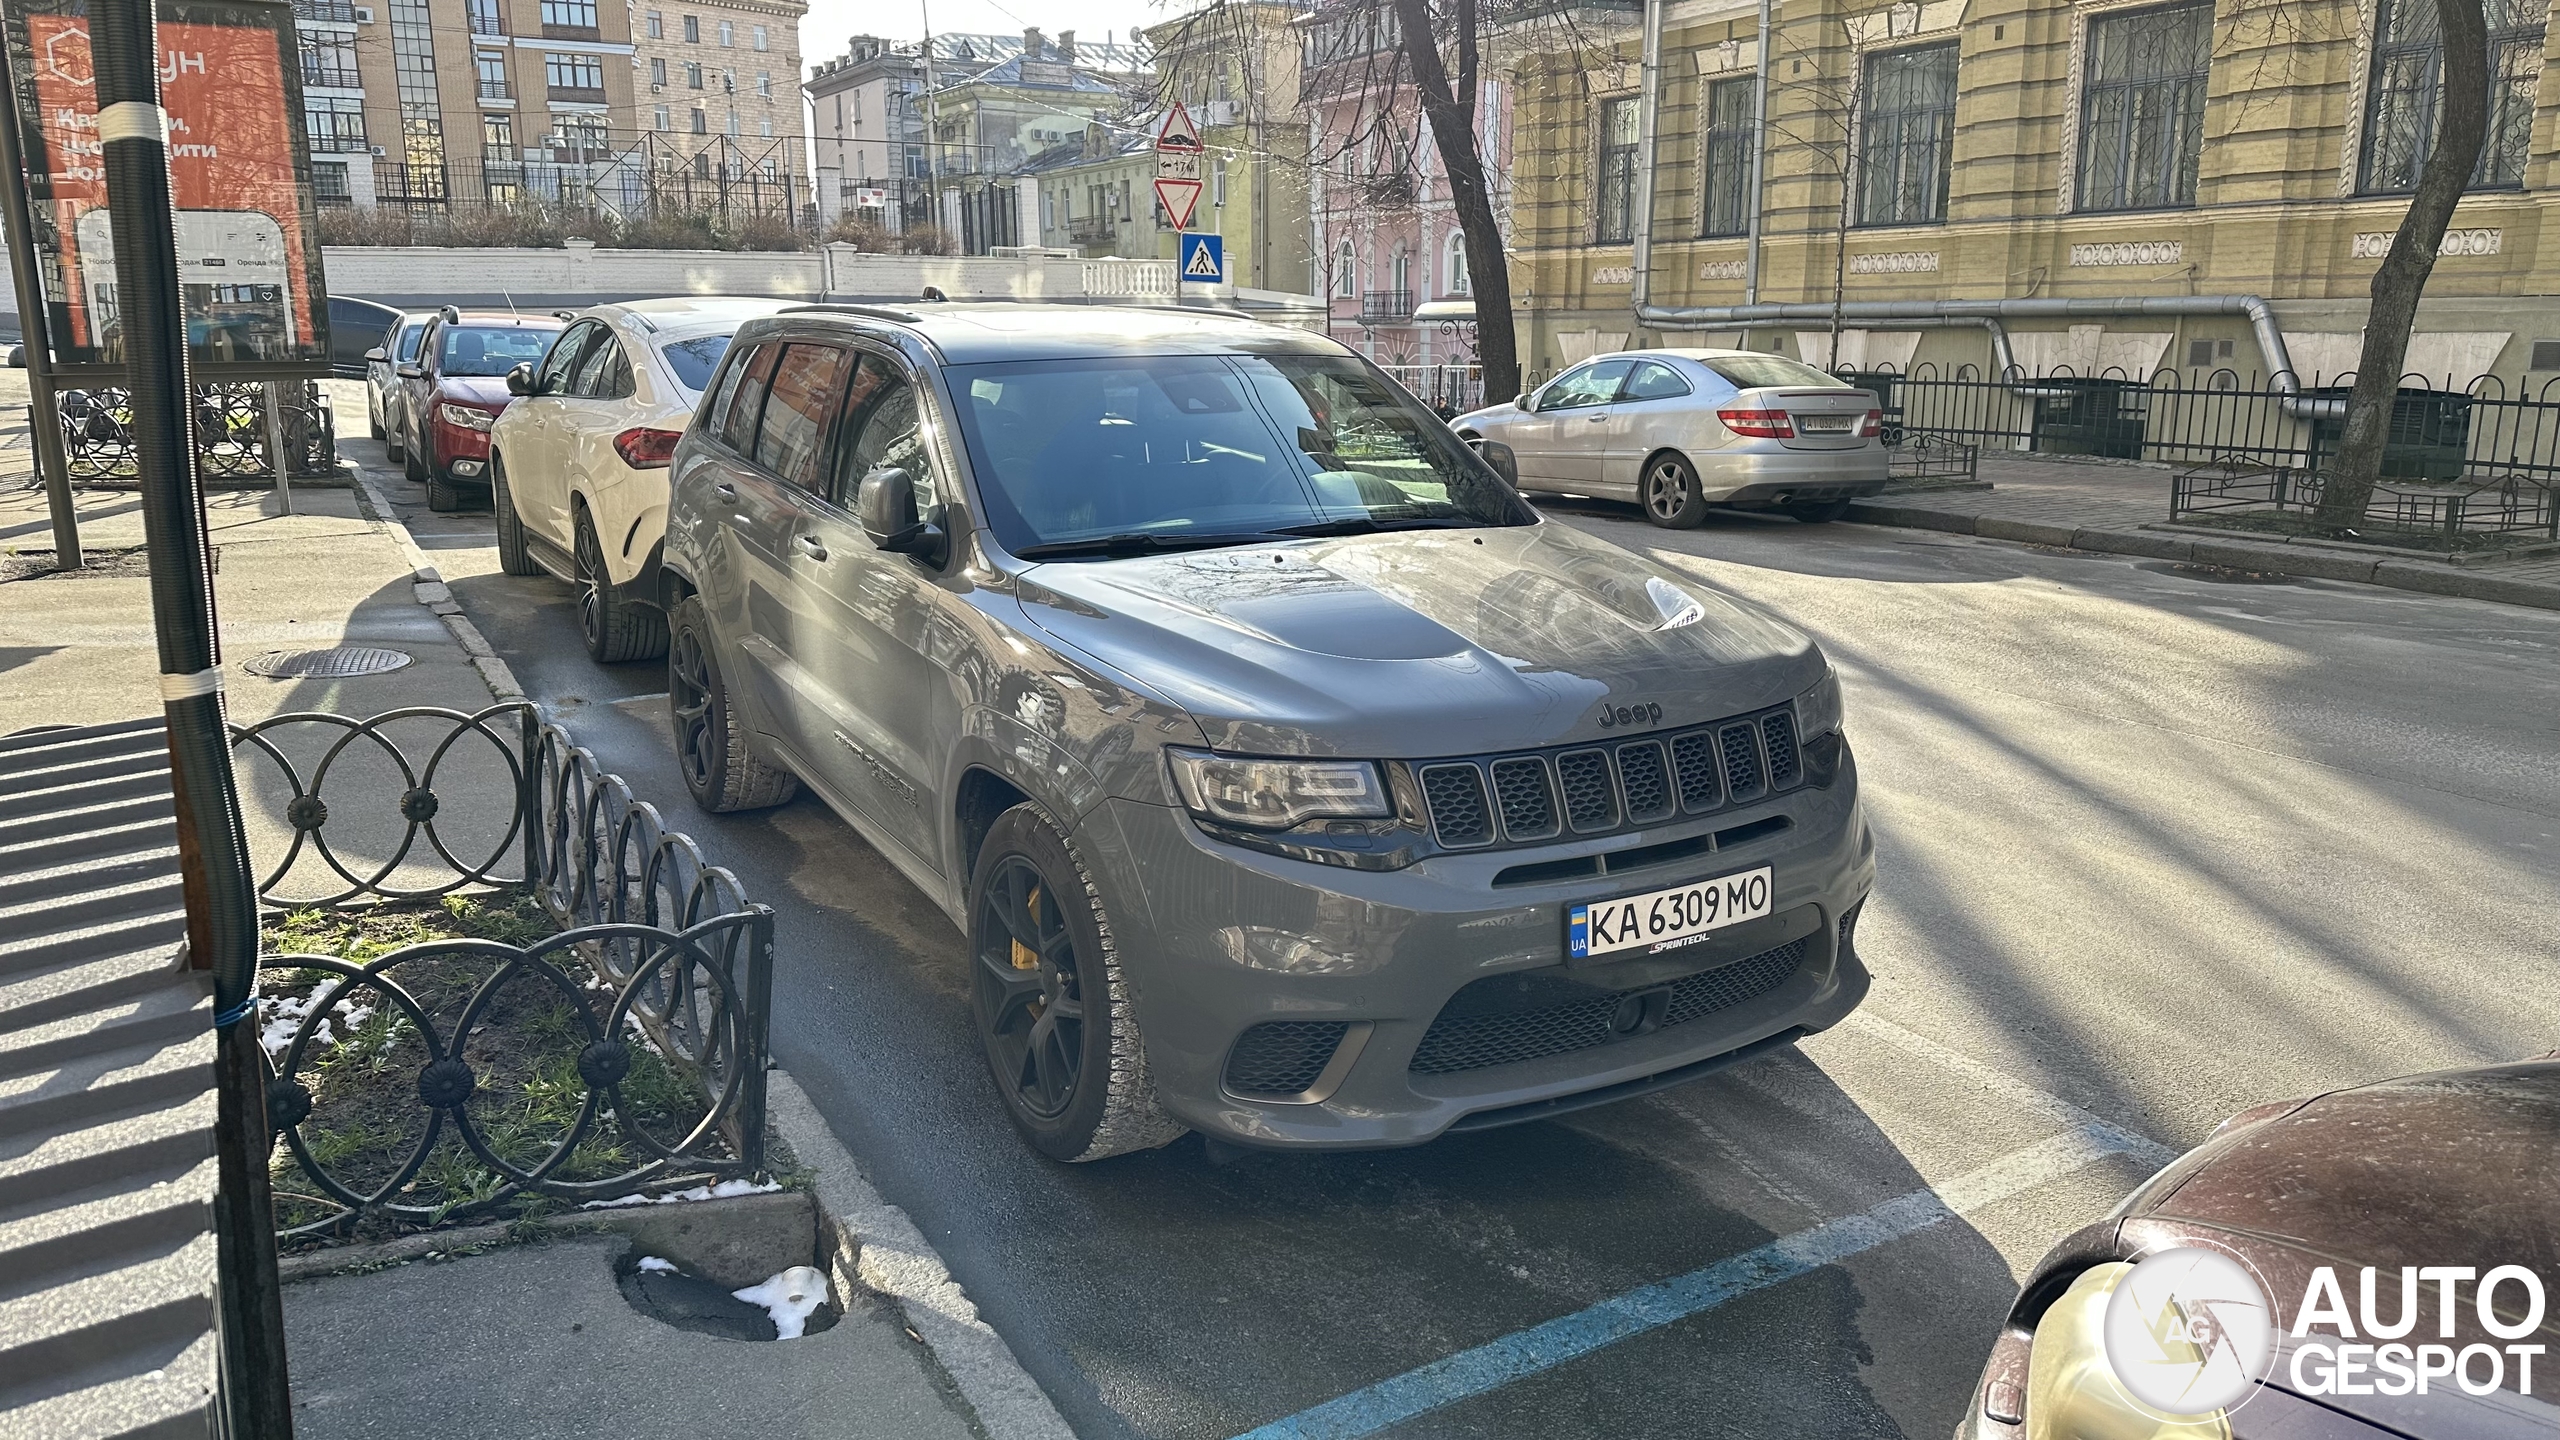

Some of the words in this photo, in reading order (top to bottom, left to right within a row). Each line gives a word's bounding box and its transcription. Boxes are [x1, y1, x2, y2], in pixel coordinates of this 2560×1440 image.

[160, 50, 206, 83] ун
[237, 258, 267, 269] Оренда
[1595, 701, 1663, 729] Jeep
[1591, 903, 1641, 947] KA
[1648, 885, 1720, 936] 6309
[1727, 874, 1767, 919] MO
[1571, 938, 1587, 952] UA
